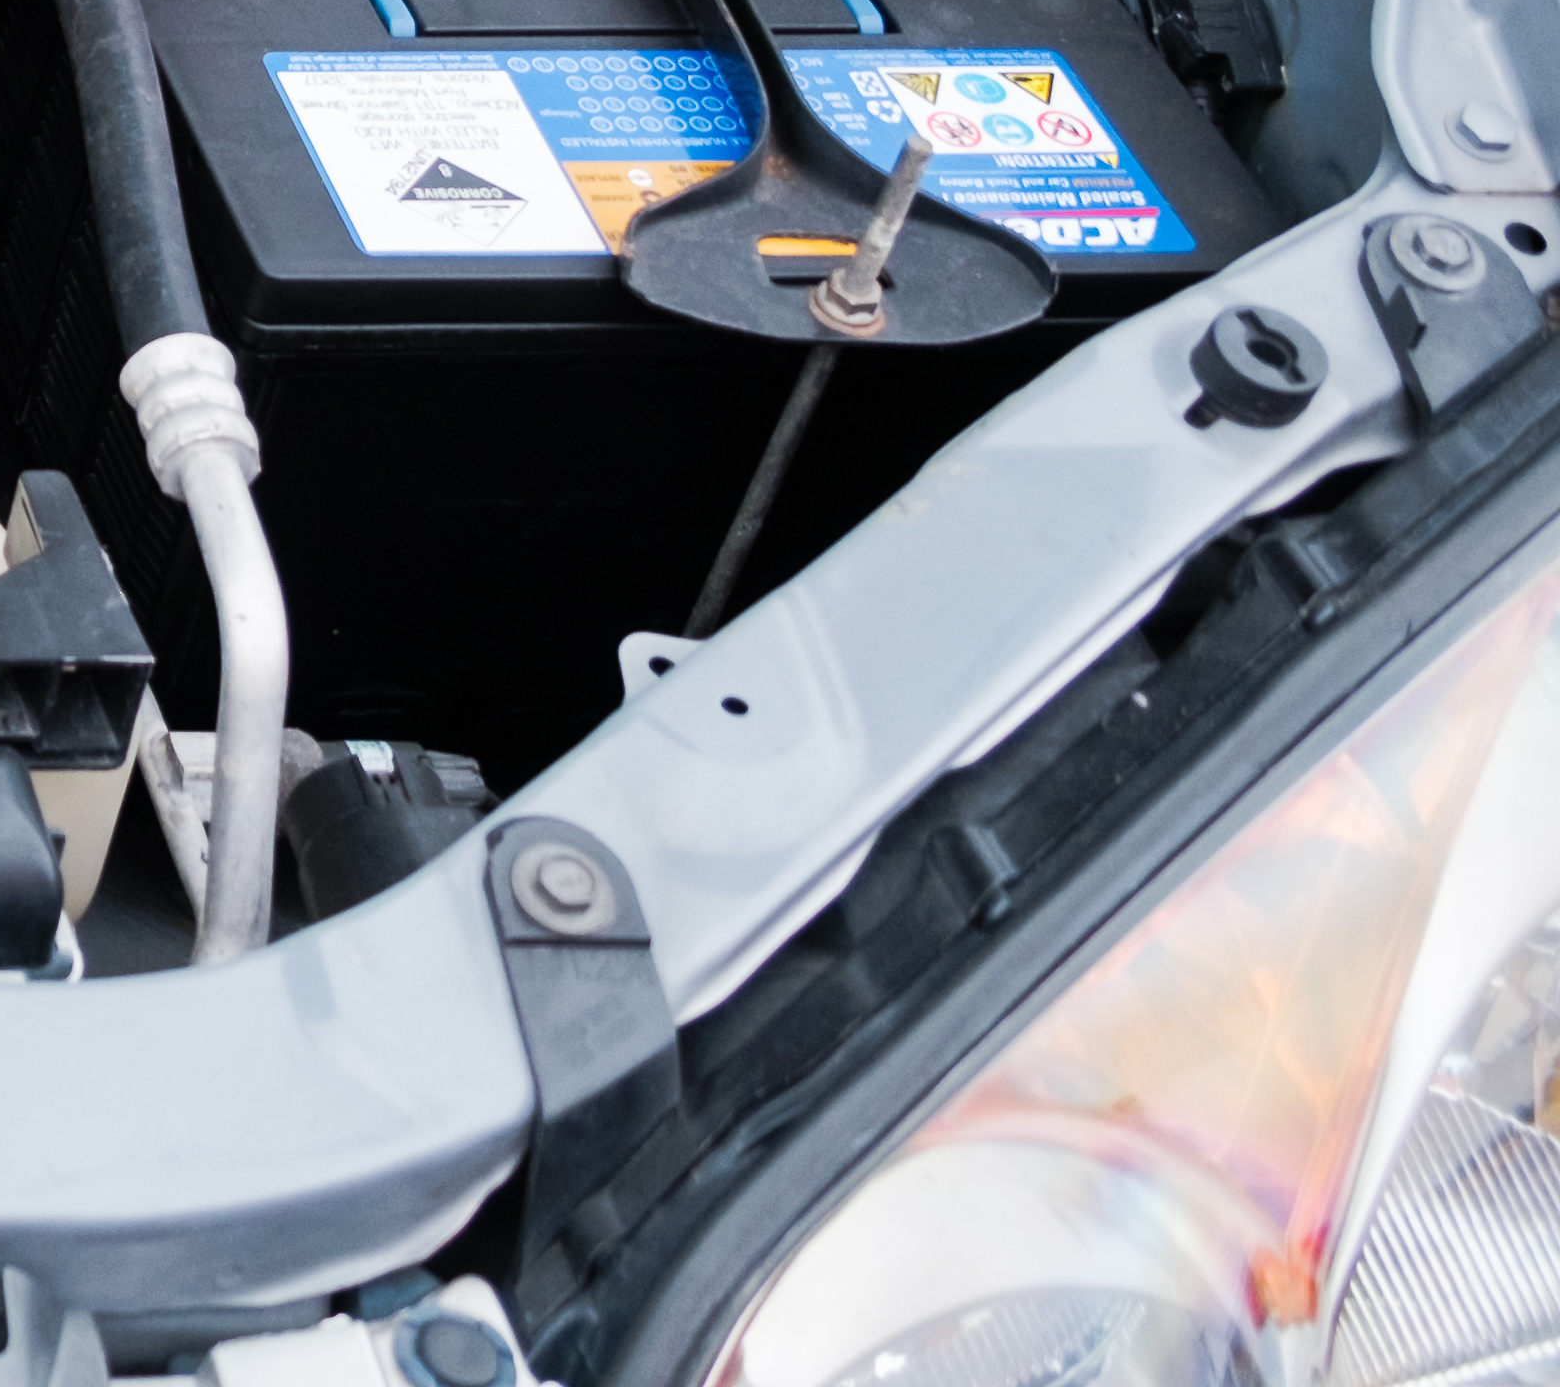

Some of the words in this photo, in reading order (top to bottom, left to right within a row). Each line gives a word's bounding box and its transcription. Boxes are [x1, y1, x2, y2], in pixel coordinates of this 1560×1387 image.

[993, 153, 1097, 168] ATTENTION!
[384, 148, 433, 195] UN2794
[436, 162, 453, 179] 8
[1021, 176, 1045, 186] and
[1047, 176, 1070, 187] Car
[414, 187, 504, 200] CORROSIVE
[954, 190, 1077, 206] Maintenance
[1079, 190, 1146, 206] Sealed
